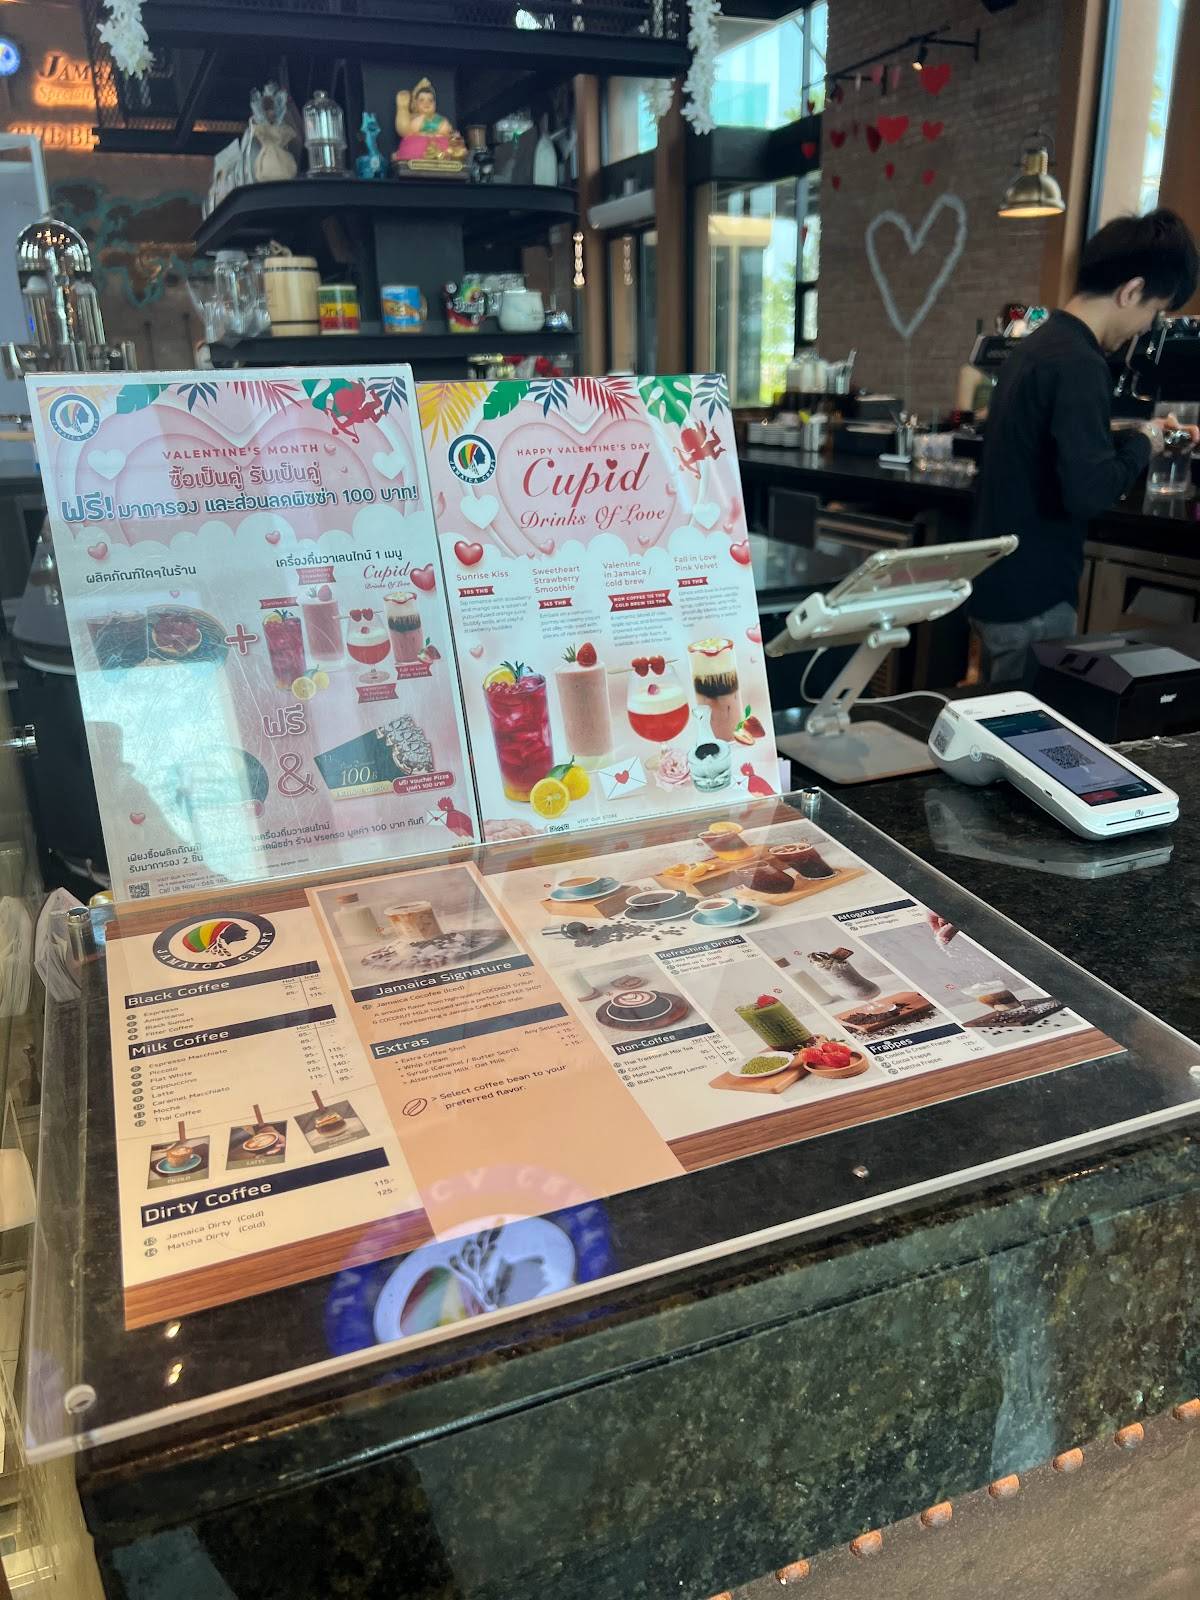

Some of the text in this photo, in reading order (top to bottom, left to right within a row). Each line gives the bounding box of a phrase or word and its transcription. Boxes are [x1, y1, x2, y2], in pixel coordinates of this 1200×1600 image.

[163, 443, 319, 460] VALENTINE'S MONTH
[517, 442, 651, 457] HAPPY VALENTINE'S DAY
[169, 461, 321, 490] ซื้อเป็นคู่ รับเป็นคู่
[523, 452, 651, 508] Cupid
[61, 491, 115, 522] ฟรี!
[118, 499, 199, 518] มาการอง
[343, 488, 374, 503] 100
[380, 485, 418, 501] บาท!
[520, 502, 666, 531] Drinks Of Love
[376, 551, 381, 560] 1
[363, 561, 411, 584] Cupid
[532, 564, 580, 576] Sweetheart
[602, 559, 641, 570] Valentine
[456, 570, 510, 583] Sunrise Kiss
[533, 575, 580, 585] Strawberry
[613, 568, 647, 578] Jamaica
[535, 583, 576, 594] Smoothie
[263, 703, 307, 737] ฟรี
[341, 766, 371, 786] 100
[371, 824, 387, 833] 100
[838, 909, 875, 920] Affogato
[157, 932, 273, 969] JAMAICA CRAFT
[659, 937, 742, 959] Refreshing Drinks
[376, 978, 437, 996] Jamaica
[440, 961, 513, 981] Signature
[128, 981, 230, 1006] Black Coffee
[377, 997, 408, 1008] Jamaica
[168, 1024, 194, 1032] Coffee
[131, 1031, 229, 1057] Milk Coffee
[375, 1038, 430, 1056] Extras
[616, 1034, 676, 1053] Non-Coffee
[869, 1038, 913, 1054] Frappes
[188, 1049, 228, 1060] Macchiato
[401, 1054, 422, 1064] Extra
[423, 1049, 447, 1058] Coffee
[149, 1066, 178, 1076] Piccolo
[403, 1062, 424, 1070] Whip
[406, 1067, 429, 1078] Syrup
[169, 1071, 193, 1080] White
[410, 1070, 452, 1083] Alternative
[439, 1064, 567, 1099] Select coffee bean to your
[151, 1089, 175, 1099] Latte
[153, 1086, 231, 1106] Caramel Macchiato
[445, 1084, 527, 1110] preferred flavor.
[174, 1108, 202, 1118] Coffee
[145, 1182, 272, 1222] Dirty Coffee
[166, 1226, 205, 1240] Jamaica
[207, 1218, 232, 1230] Dirty
[237, 1210, 265, 1222] (Cold)
[167, 1238, 203, 1251] Matcha
[205, 1230, 230, 1241] Dirty
[239, 1220, 266, 1233] (Cold)
